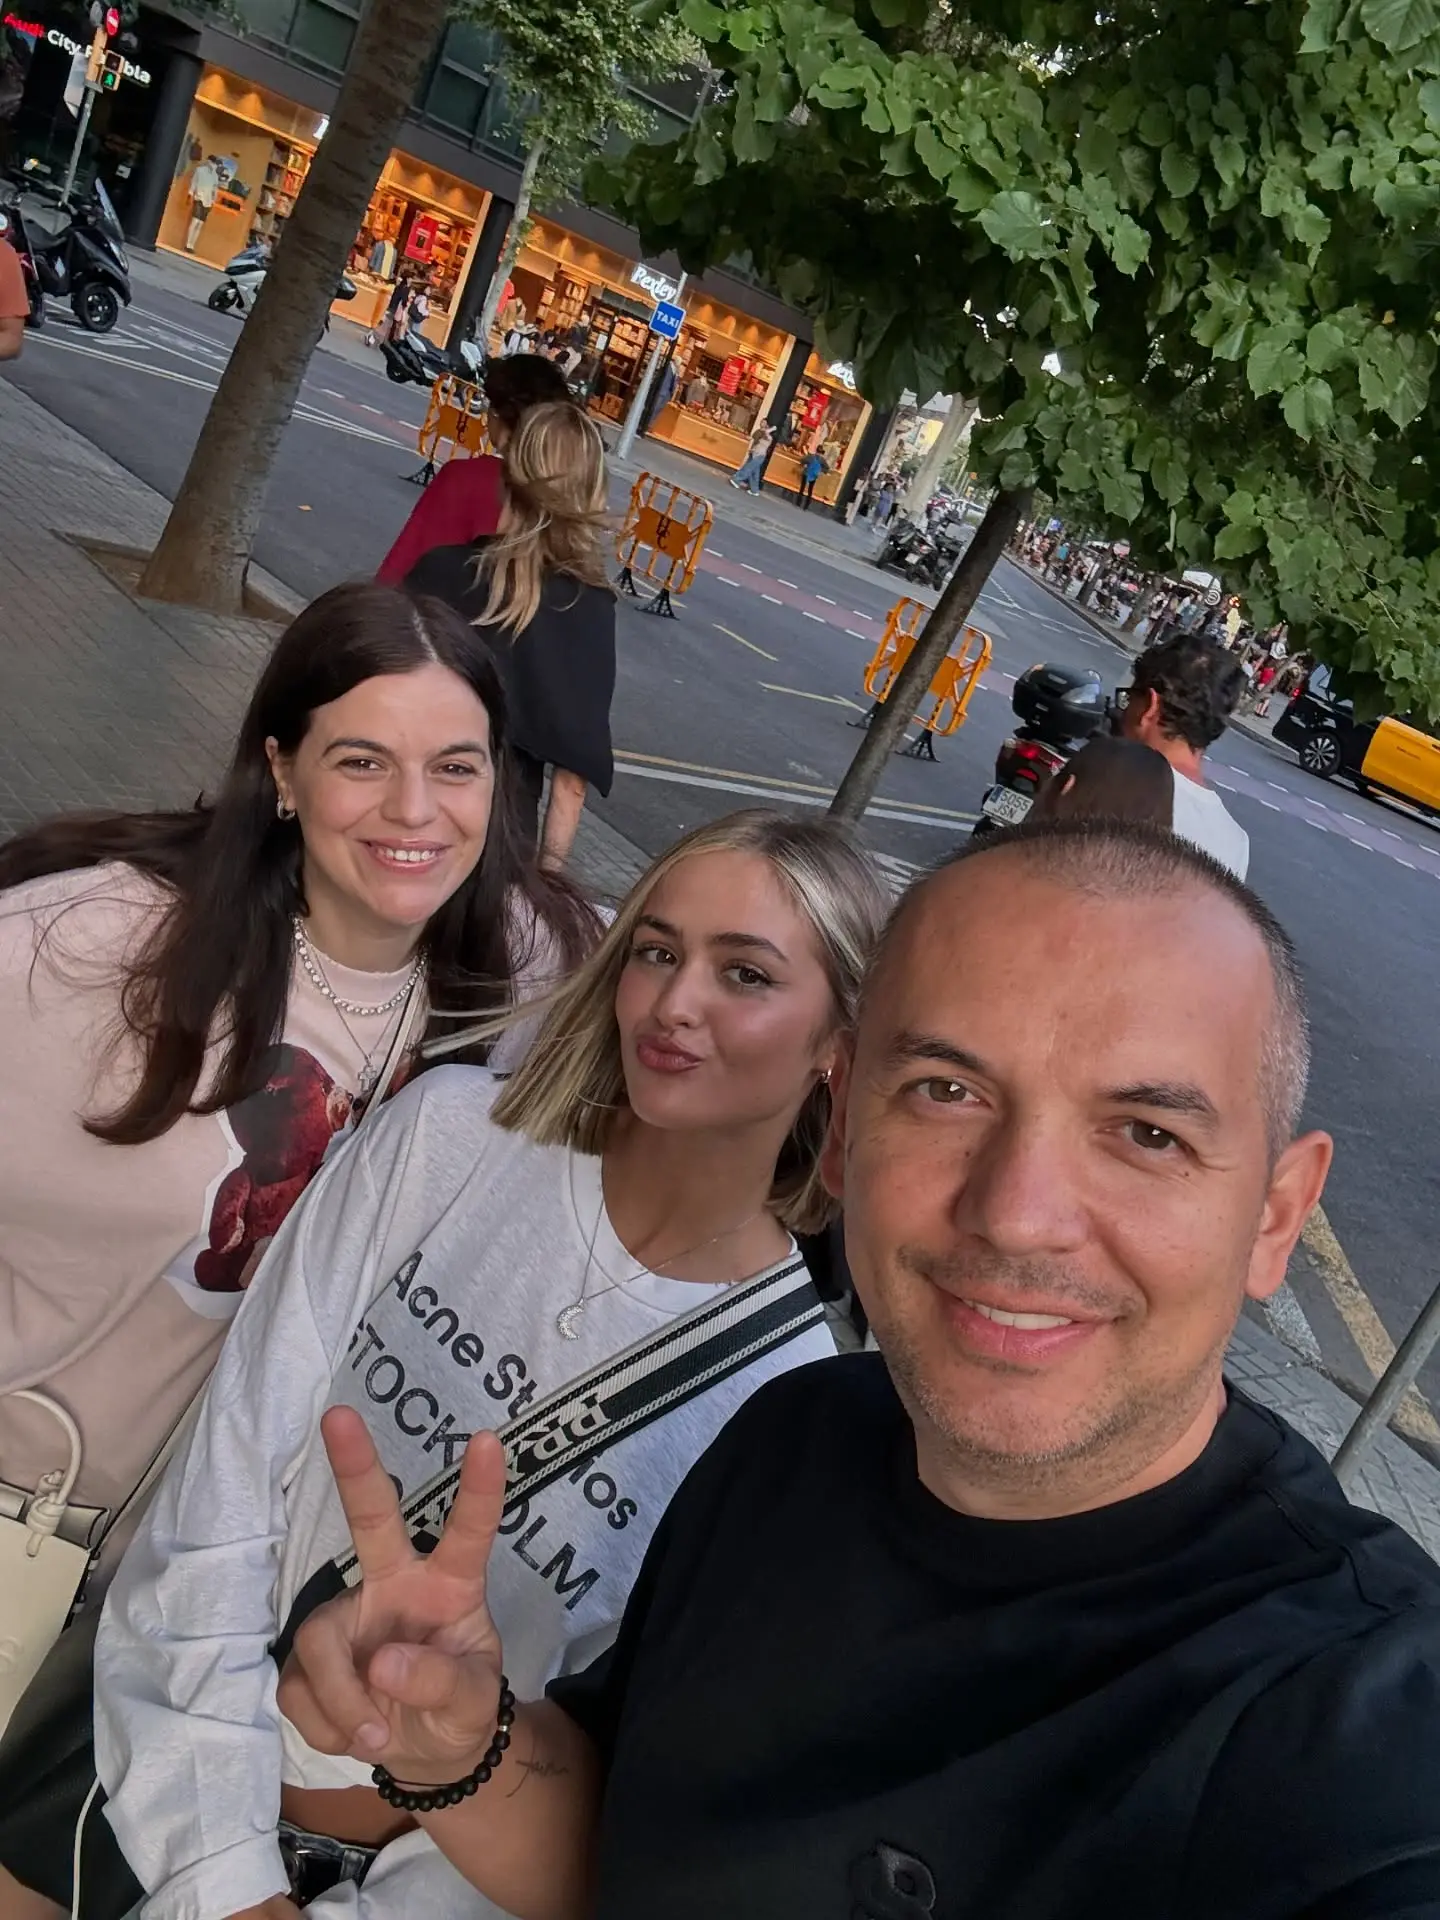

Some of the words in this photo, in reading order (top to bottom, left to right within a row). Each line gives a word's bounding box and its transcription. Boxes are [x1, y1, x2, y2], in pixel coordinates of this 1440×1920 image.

[47, 29, 82, 56] City
[657, 310, 680, 329] TAXI
[394, 1250, 485, 1368] Acne
[483, 1353, 638, 1530] Stios
[412, 1392, 612, 1540] PRAA
